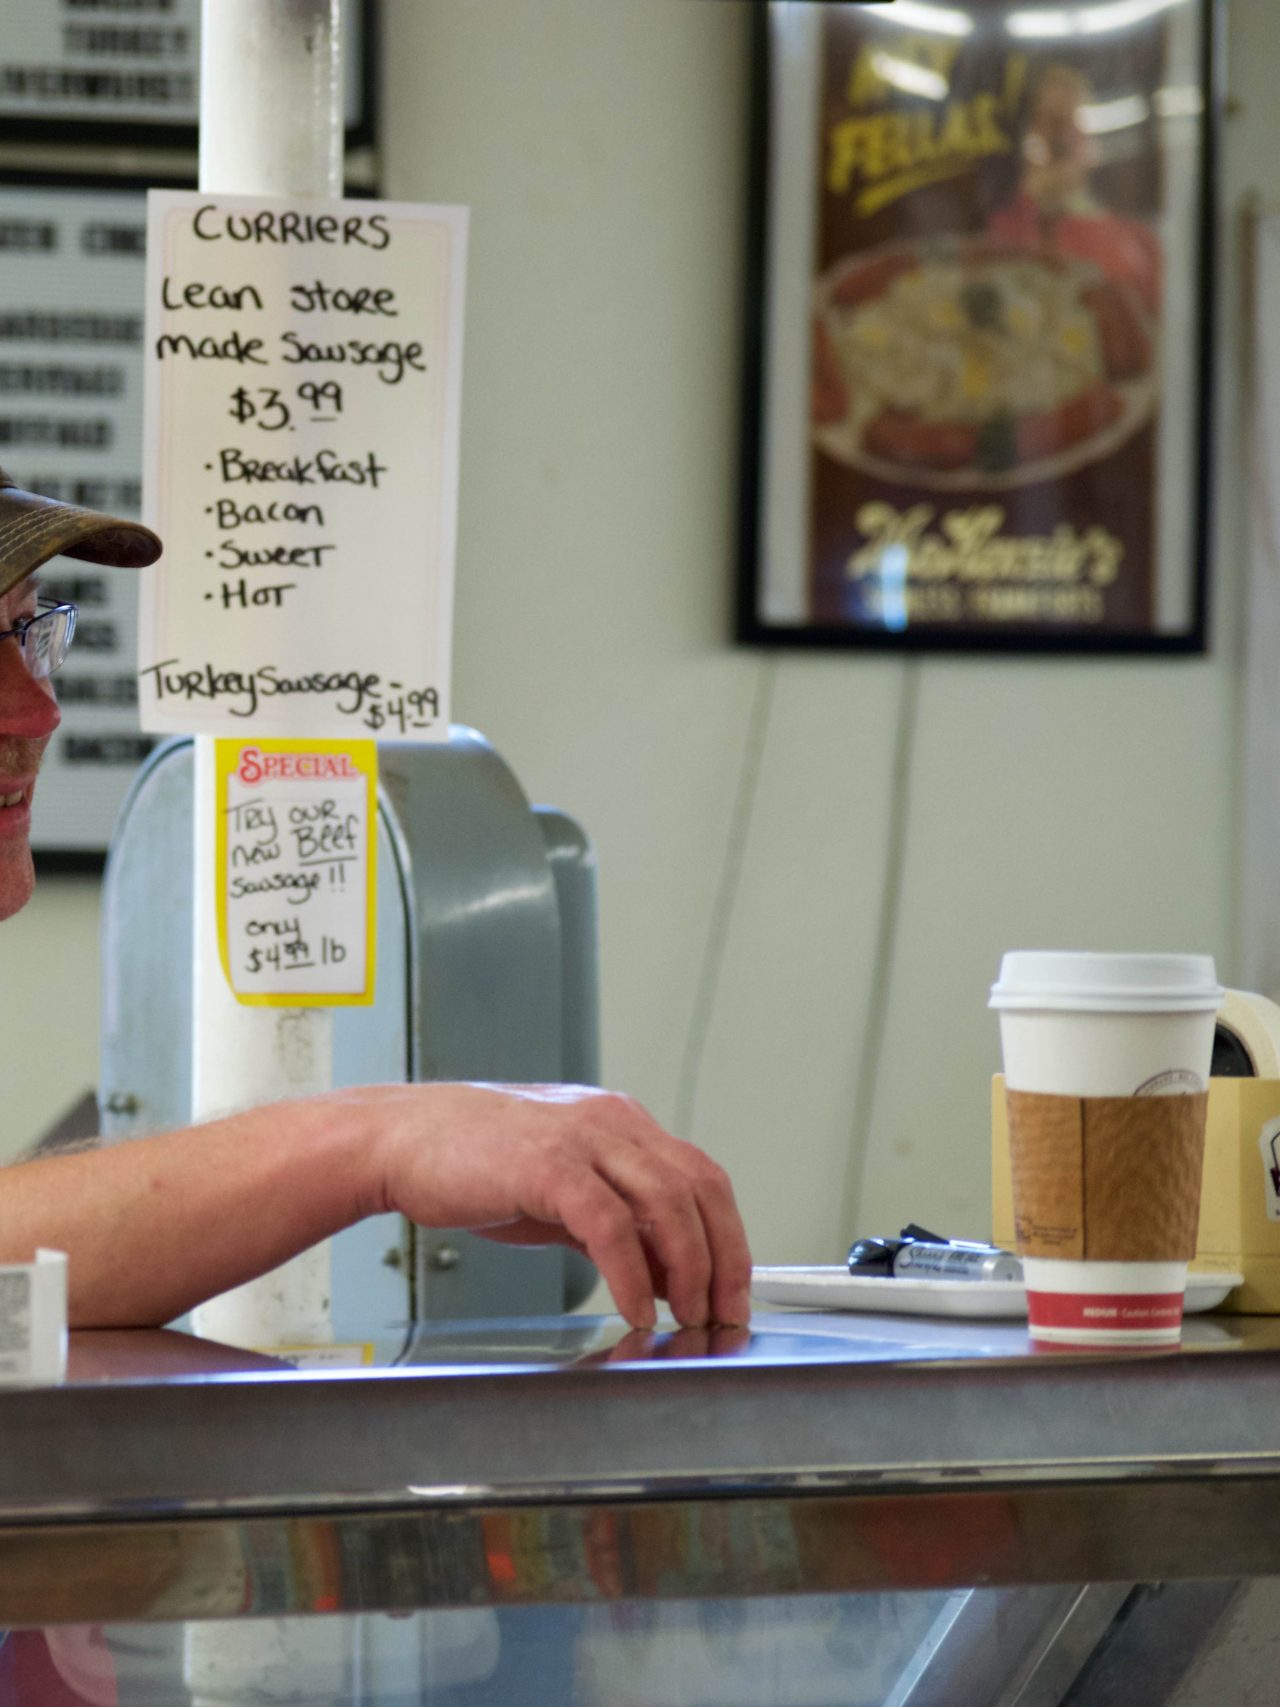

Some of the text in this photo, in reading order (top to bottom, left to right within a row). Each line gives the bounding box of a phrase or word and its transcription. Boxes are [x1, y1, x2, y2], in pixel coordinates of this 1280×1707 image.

[193, 205, 391, 251] CURRIERS
[162, 276, 263, 311] Lean
[155, 331, 427, 386] made Sausage
[216, 498, 325, 530] Bacon
[141, 659, 259, 718] Turkey
[239, 748, 358, 785] SPECIAL
[1082, 1306, 1118, 1319] MEDIUM
